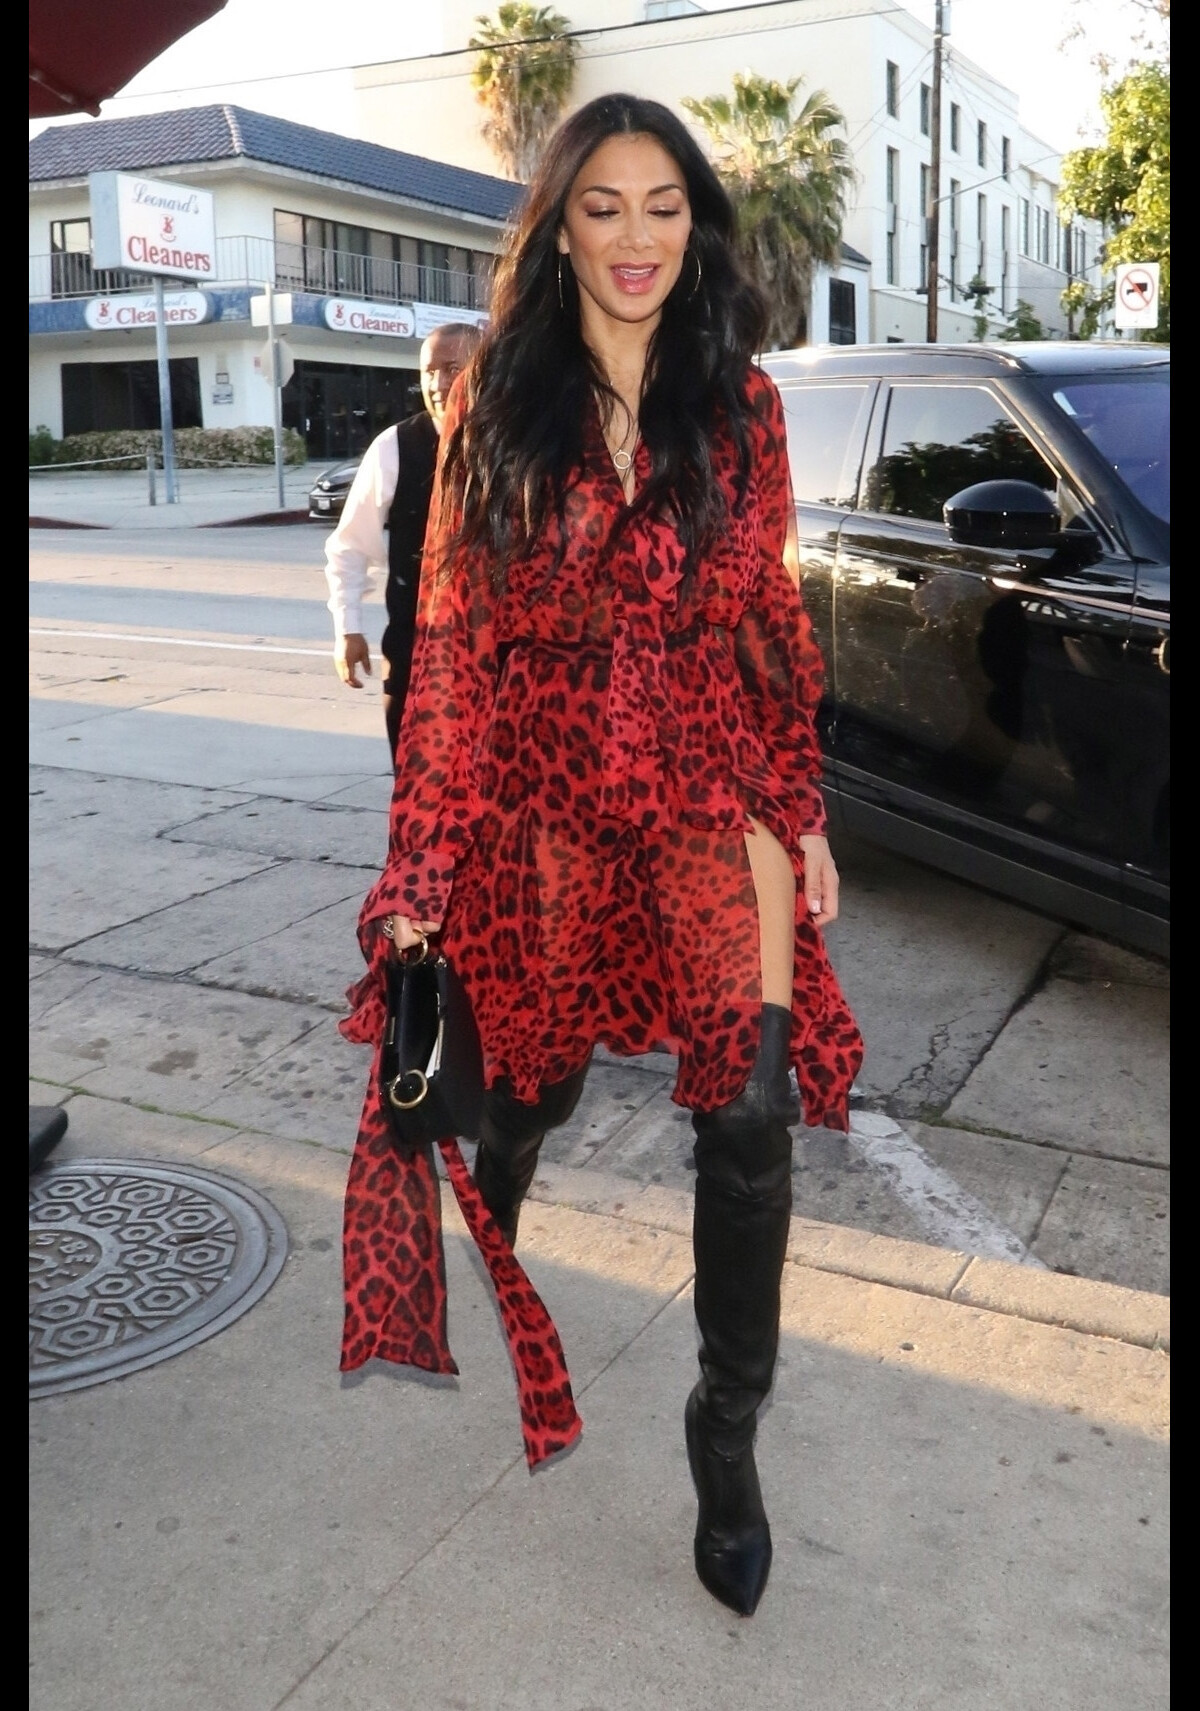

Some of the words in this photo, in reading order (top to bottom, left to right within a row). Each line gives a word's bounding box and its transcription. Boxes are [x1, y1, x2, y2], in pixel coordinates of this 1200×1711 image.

[132, 182, 199, 215] Leonard's
[127, 235, 211, 272] Cleaners
[350, 312, 409, 334] Cleaners
